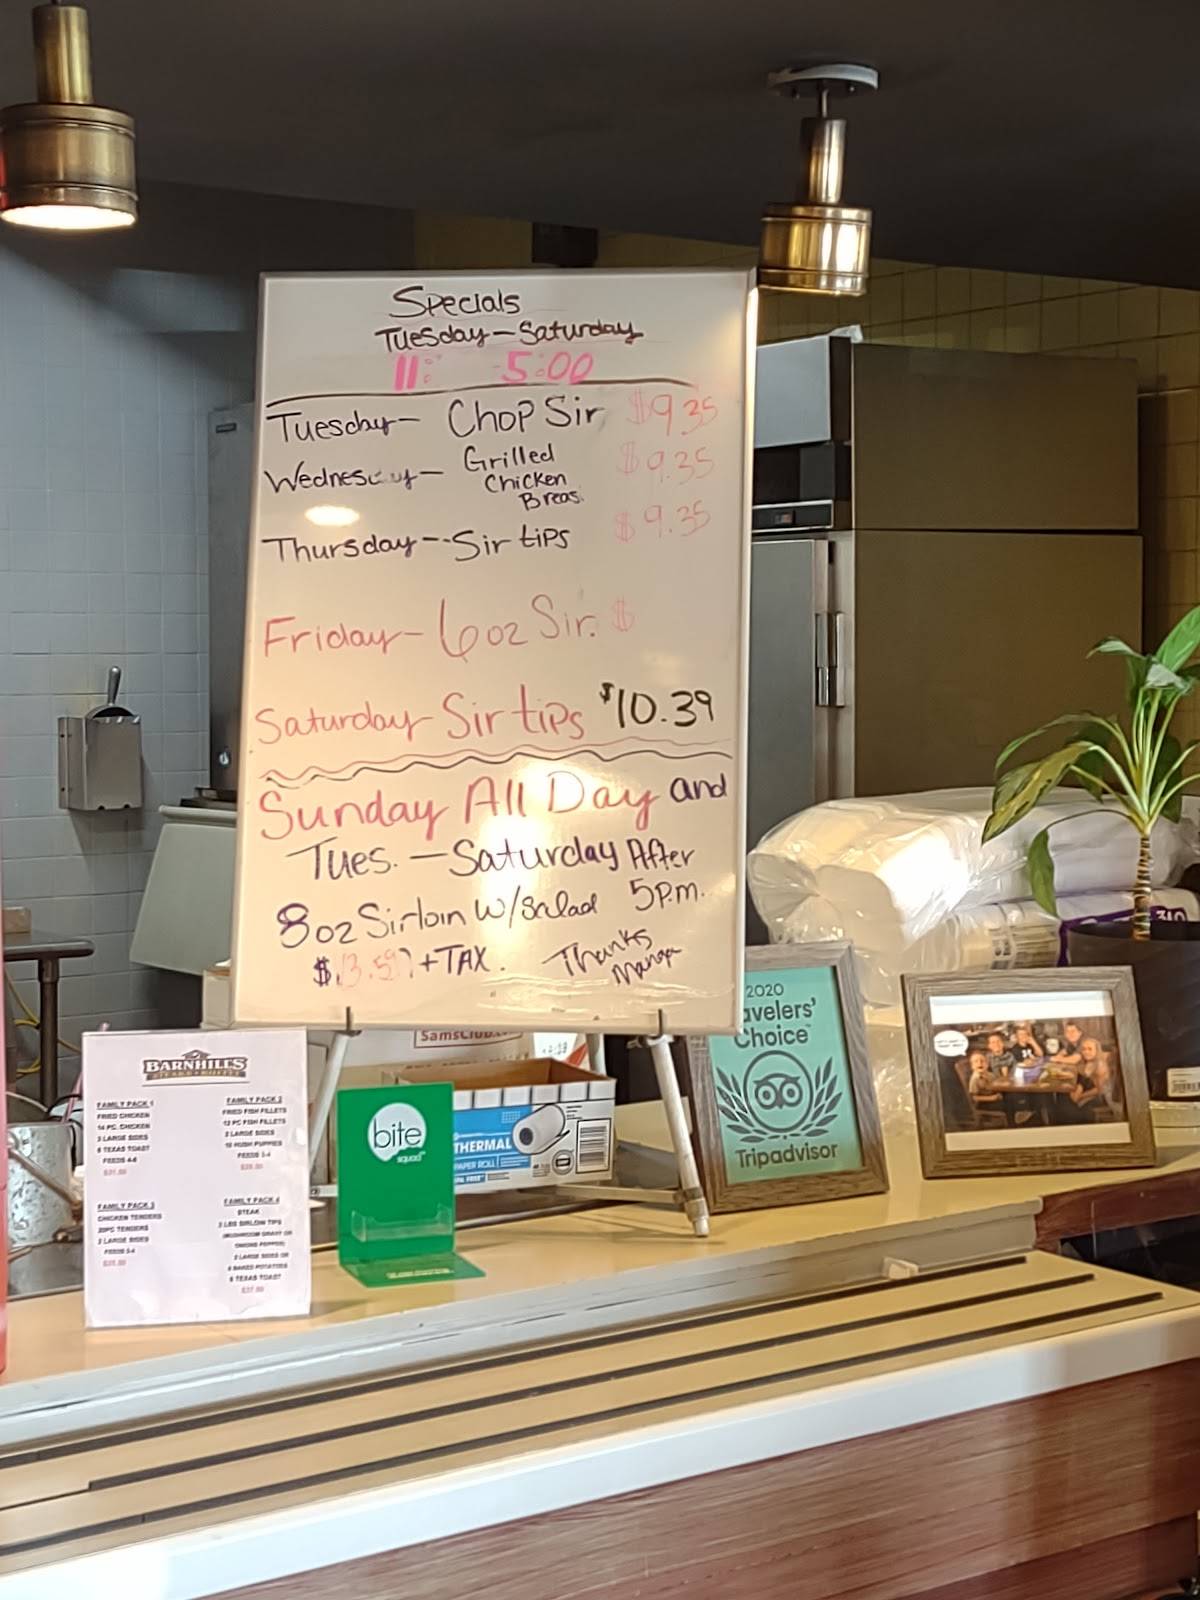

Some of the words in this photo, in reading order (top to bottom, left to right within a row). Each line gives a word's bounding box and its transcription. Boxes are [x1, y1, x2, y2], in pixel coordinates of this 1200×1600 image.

[389, 286, 520, 317] Specials
[464, 443, 555, 472] Grilled
[518, 490, 585, 511] Breas
[600, 682, 714, 729] $10.39
[259, 789, 449, 841] Sunday
[465, 776, 527, 824] All
[546, 770, 660, 831] Day
[670, 773, 727, 803] and
[285, 836, 399, 880] Tues.
[626, 838, 695, 871] After
[357, 897, 467, 939] Sirloin
[542, 928, 652, 977] Thanks
[745, 983, 784, 998] 2020
[744, 997, 816, 1022] avelers'
[734, 1024, 809, 1048] Choice
[97, 1101, 124, 1109] FAMILY
[226, 1097, 254, 1106] FAMILY
[256, 1096, 276, 1104] PACK
[374, 1117, 422, 1148] bite
[454, 1137, 512, 1154] THERMAL
[735, 1142, 838, 1169] Tripadvisor
[97, 1203, 125, 1212] FAMILY
[127, 1202, 148, 1210] PACK
[223, 1198, 251, 1207] FAMILY
[253, 1197, 273, 1205] PACK
